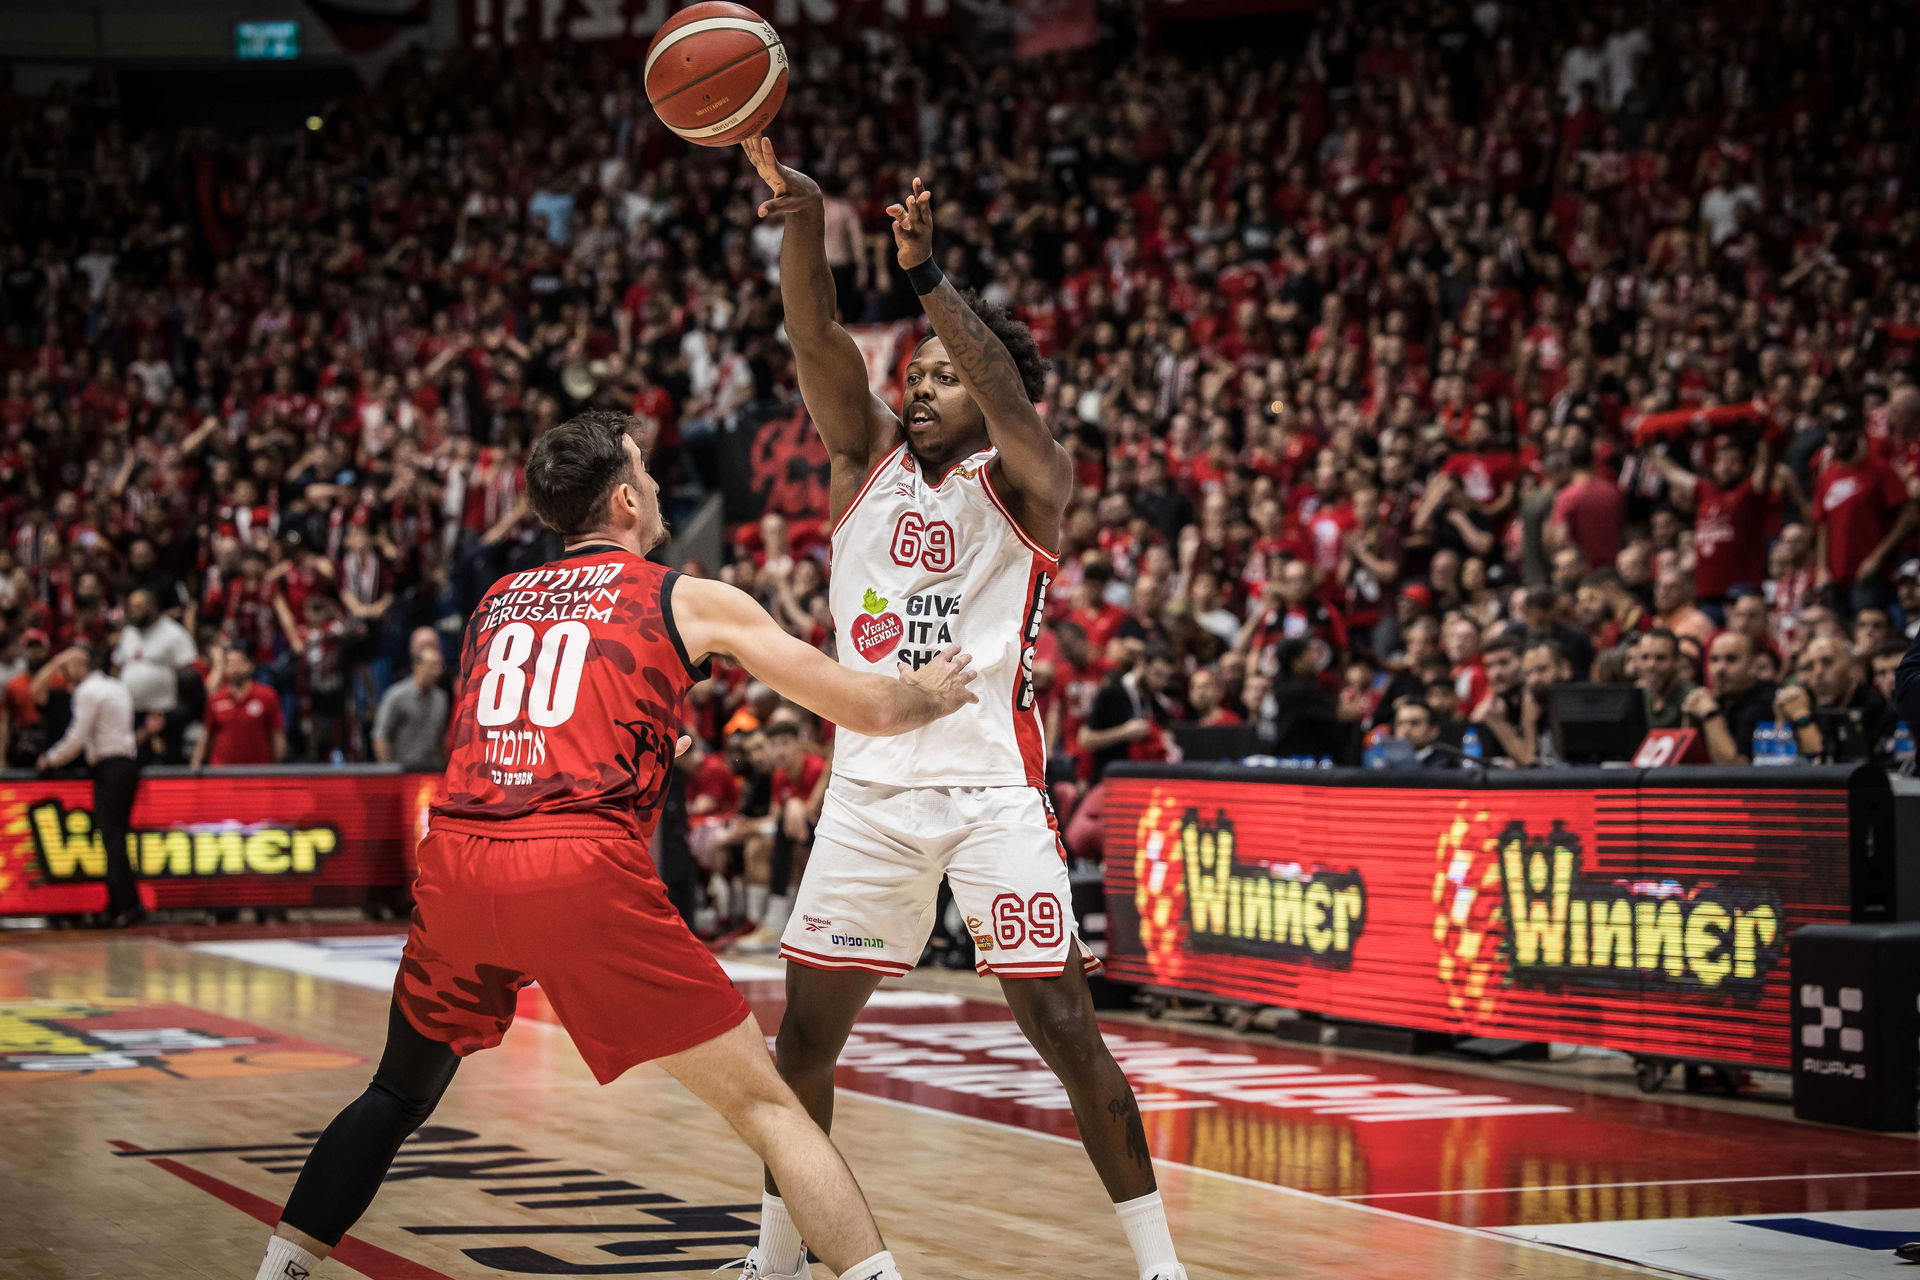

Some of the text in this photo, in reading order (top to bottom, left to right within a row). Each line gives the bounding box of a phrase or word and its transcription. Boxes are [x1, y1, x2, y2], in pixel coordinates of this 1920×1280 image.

[889, 511, 956, 573] 69
[508, 563, 625, 590] קורנליוס
[489, 588, 621, 613] MIDTOWN
[906, 594, 962, 617] GIVE
[480, 604, 613, 632] JERUSALEM
[908, 621, 952, 644] IT A
[477, 621, 590, 727] 80
[485, 729, 546, 766] ארומה
[1182, 823, 1362, 953] Winner
[803, 915, 832, 926] Reebok
[991, 892, 1063, 950] 69
[1503, 839, 1777, 986] Winner
[832, 932, 884, 948] מגה ספורט
